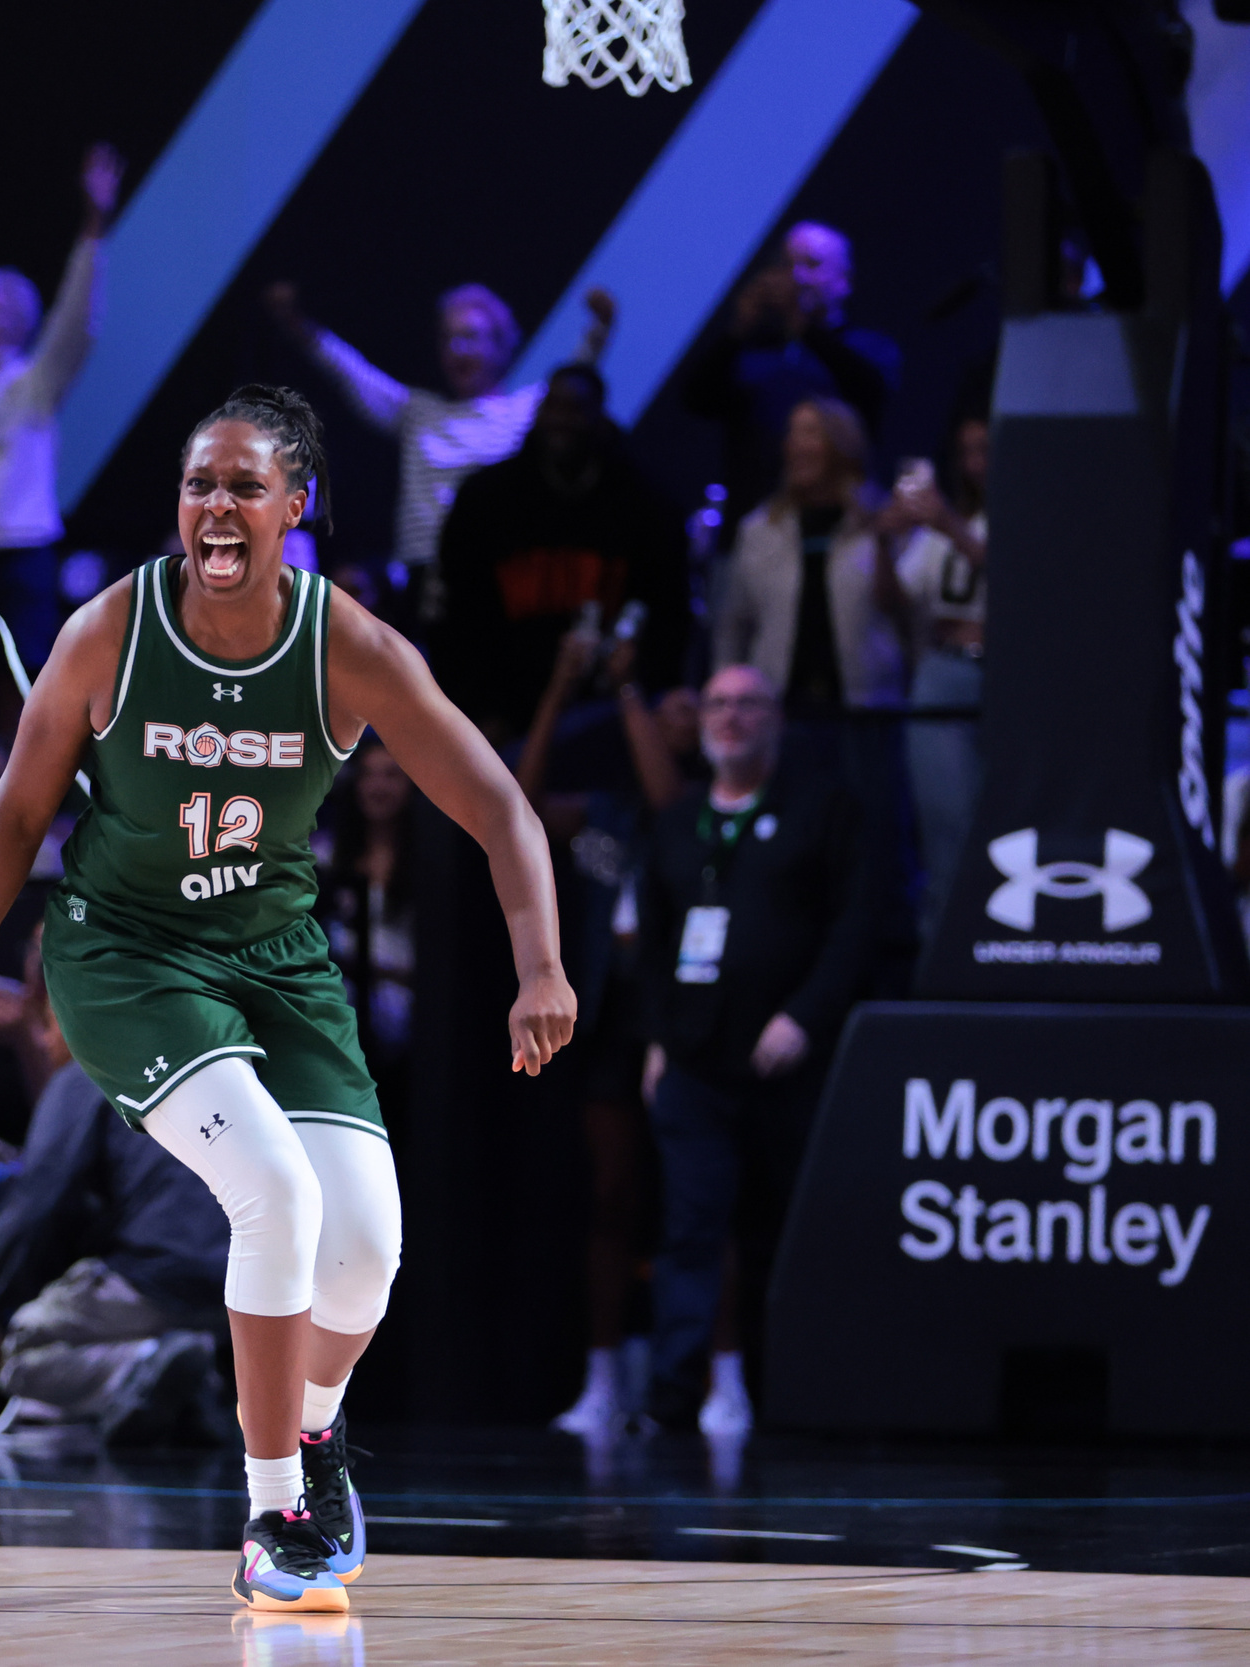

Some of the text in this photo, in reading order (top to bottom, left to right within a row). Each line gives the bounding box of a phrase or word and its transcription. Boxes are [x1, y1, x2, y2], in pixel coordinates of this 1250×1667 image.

[143, 721, 305, 768] ROSE
[179, 792, 264, 859] 12
[902, 1077, 1217, 1184] Morgan
[899, 1179, 1211, 1287] Stanley
